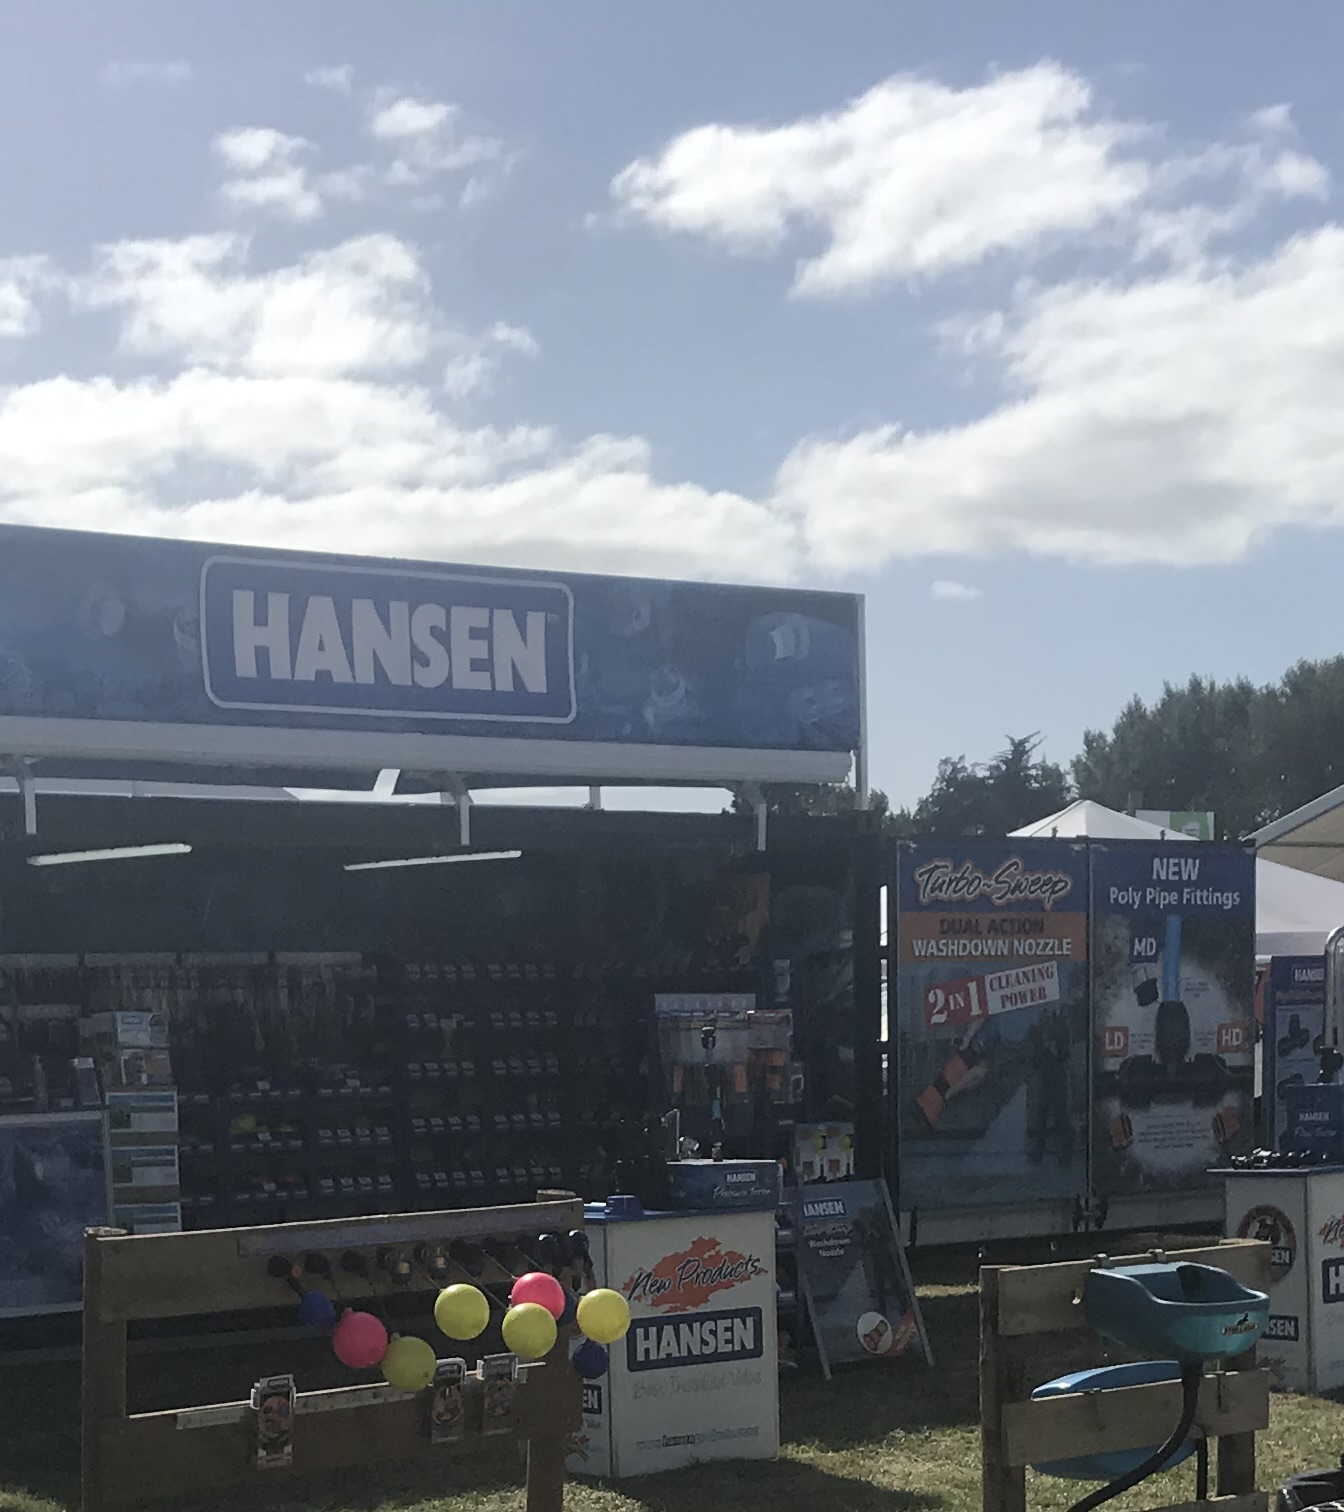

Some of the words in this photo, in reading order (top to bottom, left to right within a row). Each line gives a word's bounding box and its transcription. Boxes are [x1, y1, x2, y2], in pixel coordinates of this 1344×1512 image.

[232, 588, 548, 694] HANSEN
[1151, 857, 1201, 881] NEW
[1109, 887, 1143, 909] Poly
[1146, 887, 1178, 909] Pipe
[1182, 887, 1241, 910] Fittings
[939, 918, 983, 935] DUAL
[987, 917, 1045, 936] ACTION
[912, 938, 1010, 957] WASHDOWN
[1013, 938, 1073, 956] NOZZLE
[1133, 937, 1157, 956] MD
[989, 965, 1055, 992] CLEANING
[1000, 987, 1048, 1009] POWER
[1105, 1031, 1124, 1050] LD
[1221, 1028, 1244, 1047] HD
[628, 1269, 672, 1301] New
[677, 1254, 761, 1292] Products
[636, 1316, 755, 1363] HANSEN
